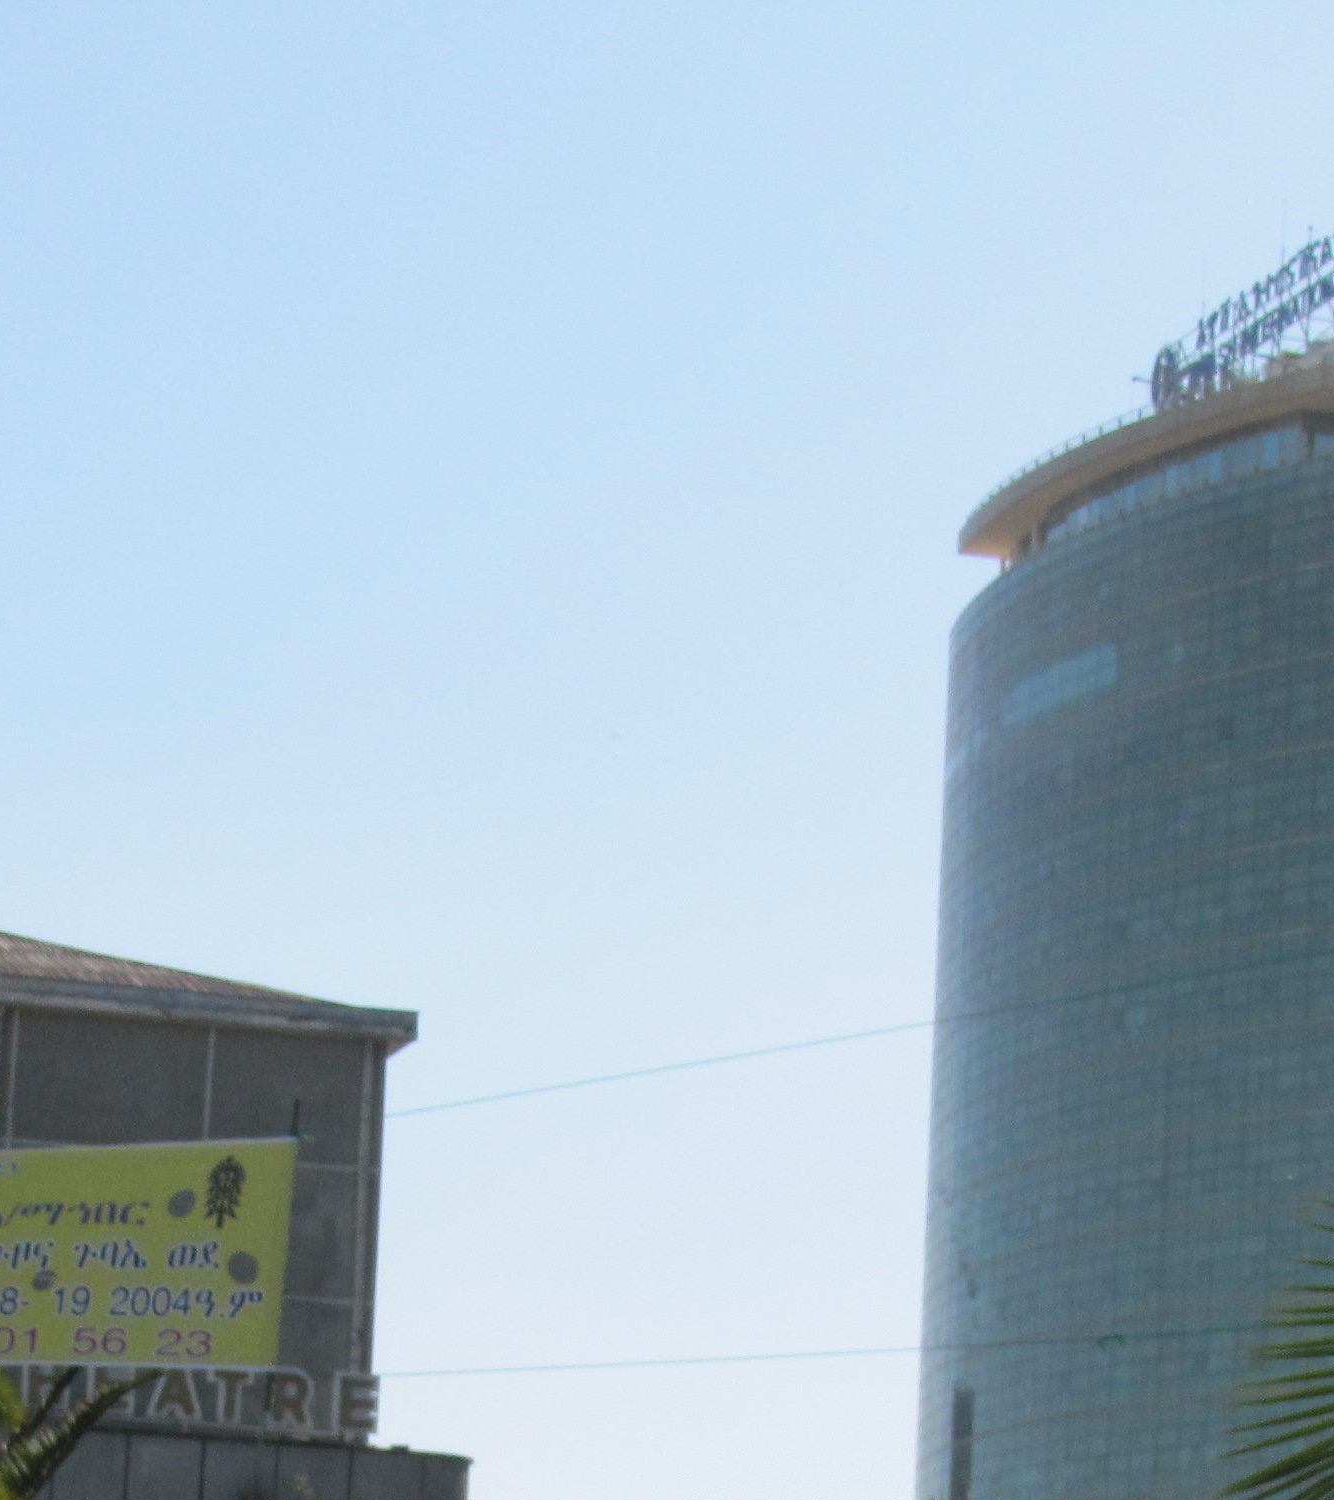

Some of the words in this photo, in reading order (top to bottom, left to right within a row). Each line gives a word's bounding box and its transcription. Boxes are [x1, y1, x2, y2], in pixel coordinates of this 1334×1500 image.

[167, 1240, 221, 1269] ወደ
[53, 1285, 92, 1316] 19
[71, 1326, 128, 1356] 56
[154, 1328, 214, 1359] 23
